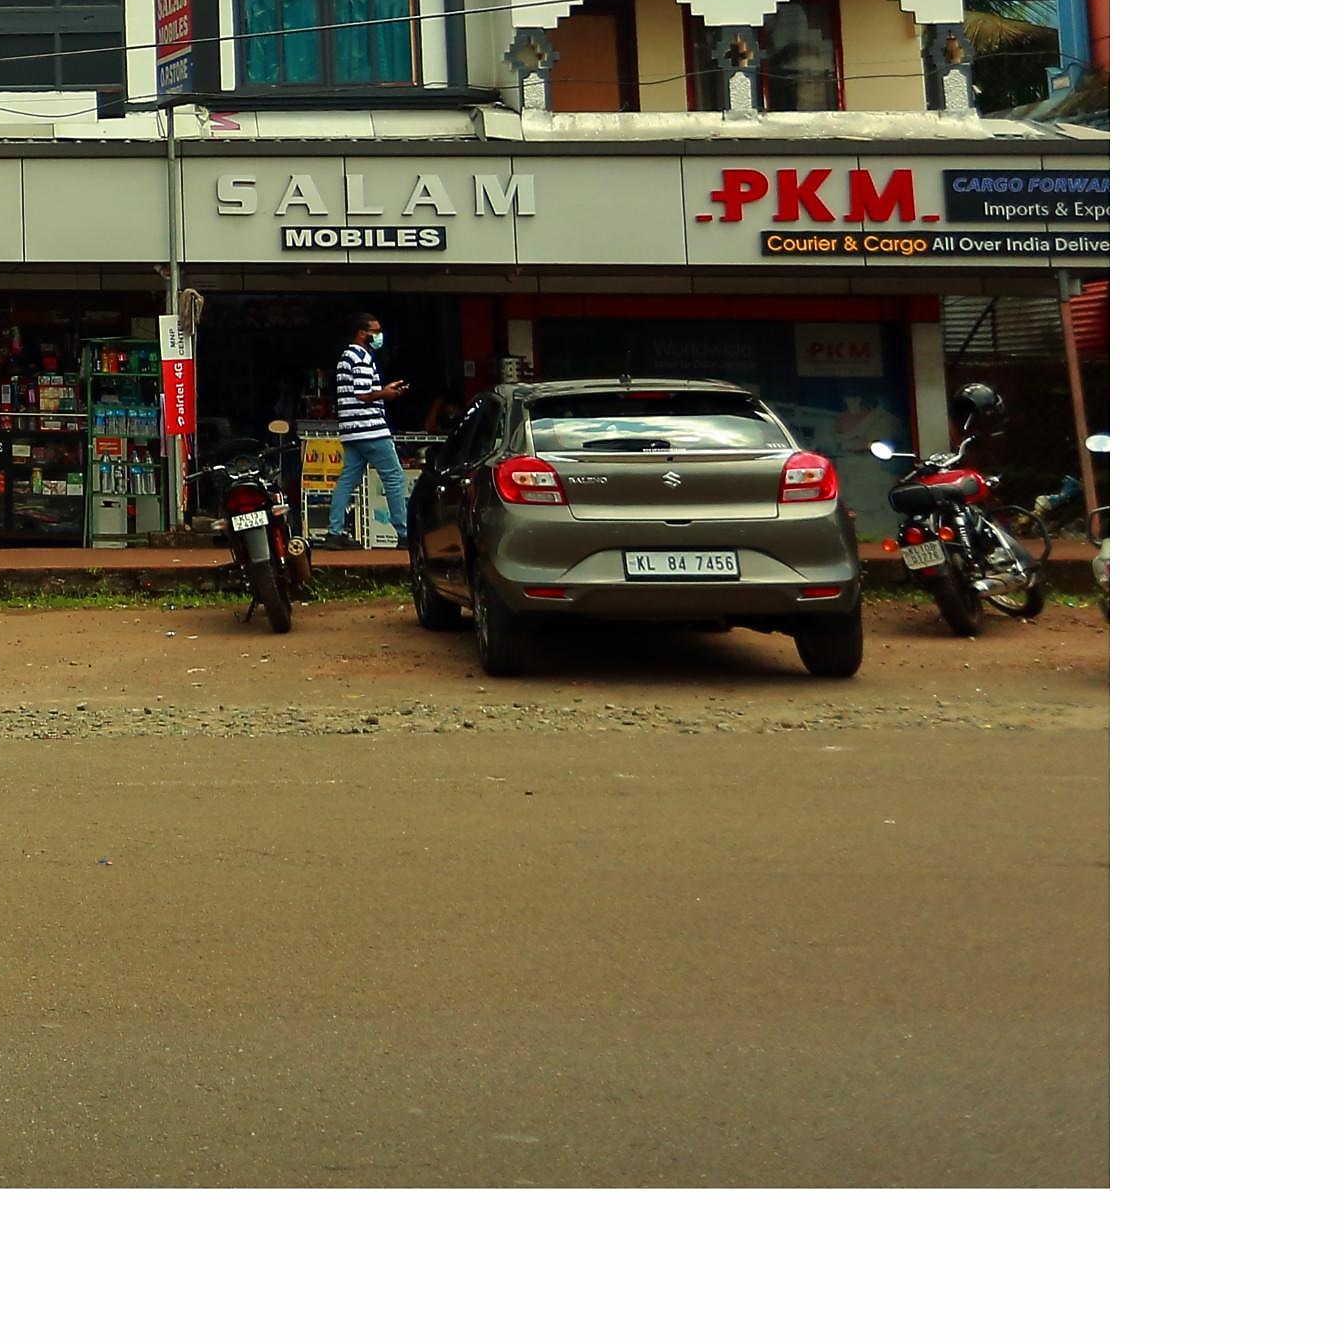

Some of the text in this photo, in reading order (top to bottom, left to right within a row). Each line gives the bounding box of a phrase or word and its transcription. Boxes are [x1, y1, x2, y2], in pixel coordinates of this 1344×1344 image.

[158, 15, 189, 45] MOBILES
[216, 173, 537, 216] SALAM
[952, 177, 1024, 193] CARGO
[709, 168, 919, 223] PKM
[984, 202, 1049, 220] Imports
[1055, 202, 1068, 216] &
[285, 228, 441, 247] MOBILES
[767, 236, 1110, 255] Courier & Cargo All Over India Delive
[168, 328, 176, 348] MNP
[807, 341, 871, 359] PKM
[174, 362, 185, 414] airtel 4G
[636, 556, 734, 570] KL 84 7456
